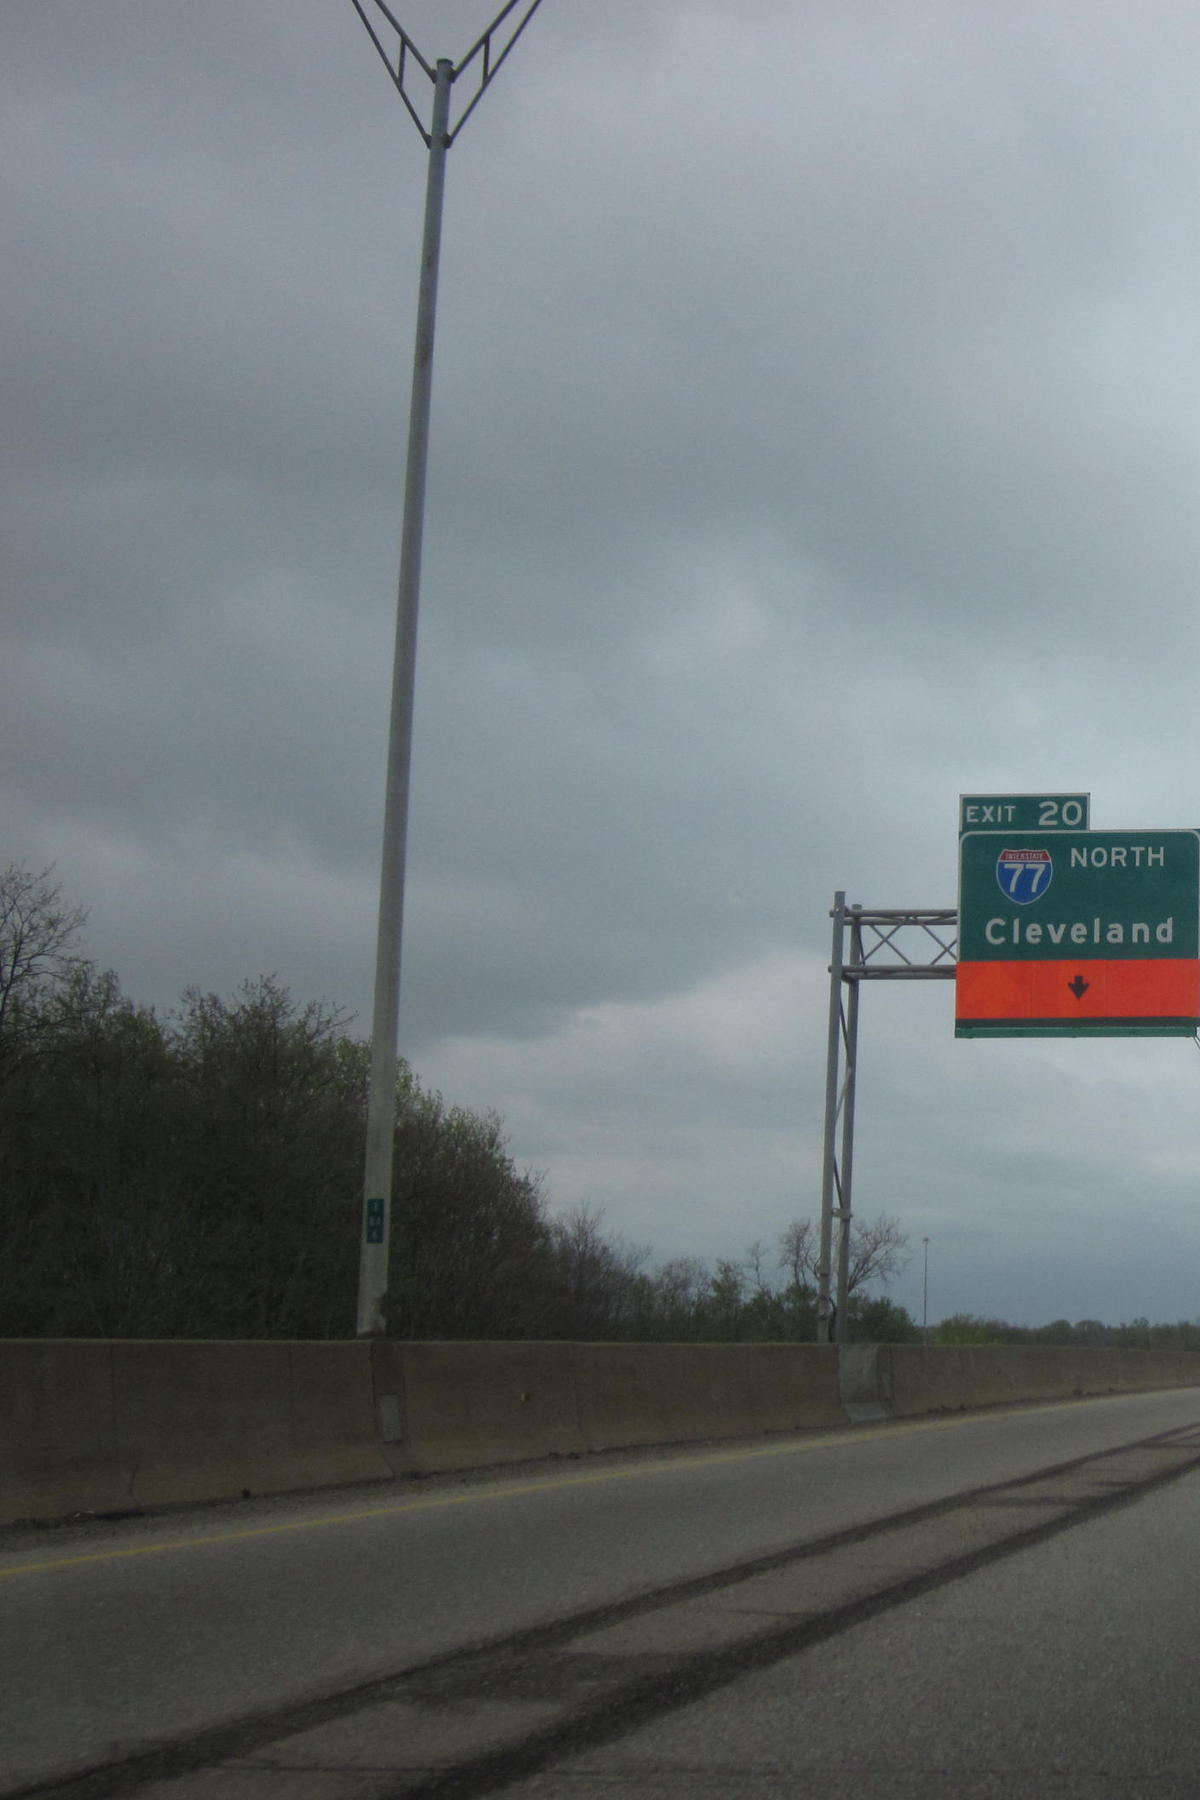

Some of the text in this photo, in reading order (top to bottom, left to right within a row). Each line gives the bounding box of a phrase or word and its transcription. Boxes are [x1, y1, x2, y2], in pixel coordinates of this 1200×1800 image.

[966, 801, 1082, 826] EXIT 20
[1005, 853, 1043, 861] INTERSTATE
[1070, 847, 1165, 867] NORTH
[1004, 863, 1046, 893] 77
[985, 917, 1173, 945] Cleveland
